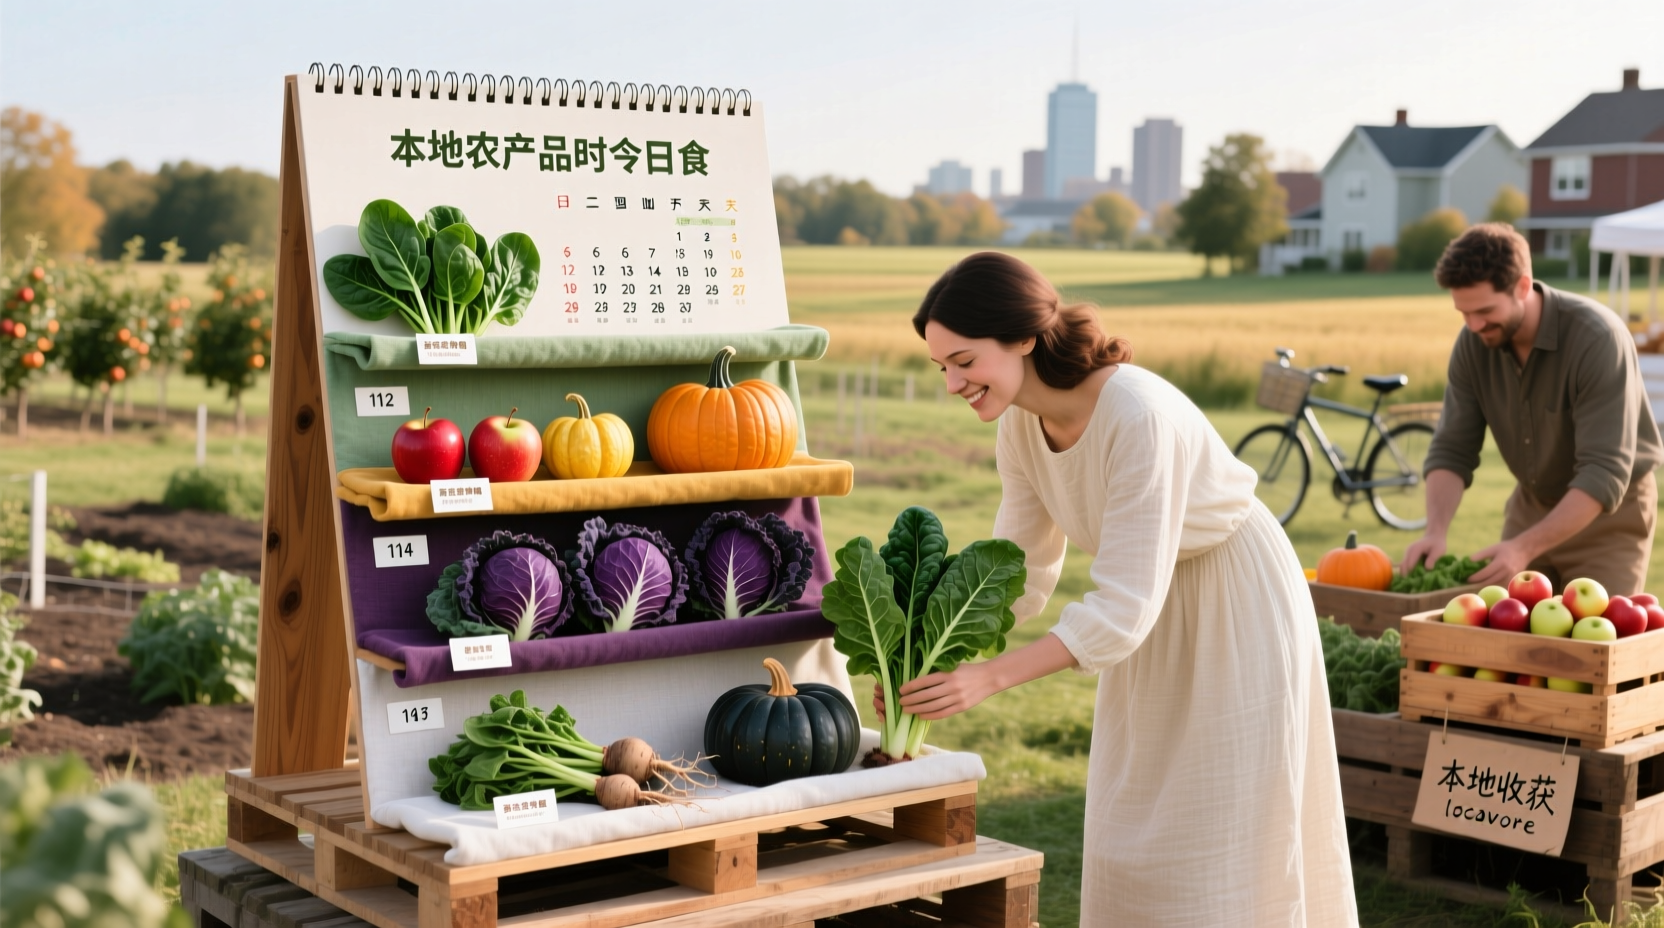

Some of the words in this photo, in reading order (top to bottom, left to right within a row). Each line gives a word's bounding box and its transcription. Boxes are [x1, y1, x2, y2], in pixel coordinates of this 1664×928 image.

[390, 128, 710, 177] 本地农产品时今日食
[557, 195, 570, 209] 日
[586, 197, 599, 209] 二
[676, 231, 681, 241] 1
[592, 246, 600, 258] 6
[621, 247, 629, 258] 6
[648, 248, 656, 258] 7
[561, 264, 575, 276] 12
[620, 265, 634, 277] 13
[648, 265, 661, 277] 14
[621, 283, 635, 295] 20
[649, 283, 662, 295] 21
[732, 284, 745, 296] 27
[369, 392, 395, 408] 112
[387, 542, 414, 558] 114
[1437, 759, 1556, 816] 本地收获
[1445, 798, 1535, 835] locavore
